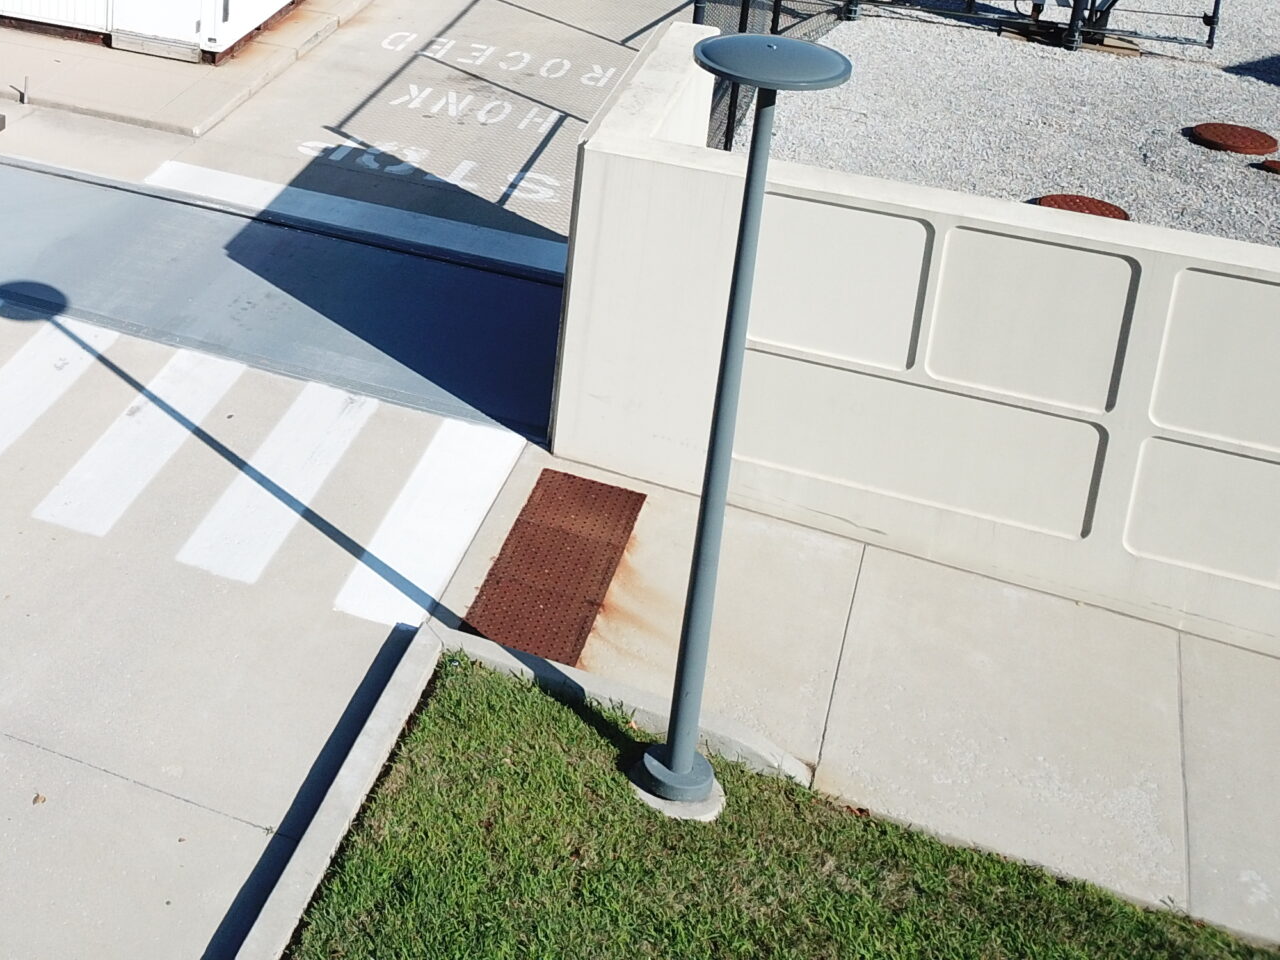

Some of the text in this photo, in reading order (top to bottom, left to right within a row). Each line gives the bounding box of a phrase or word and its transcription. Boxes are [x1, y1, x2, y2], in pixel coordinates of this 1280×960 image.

[381, 32, 616, 87] ROCEED
[389, 83, 566, 133] HONK
[297, 139, 561, 203] STOP
